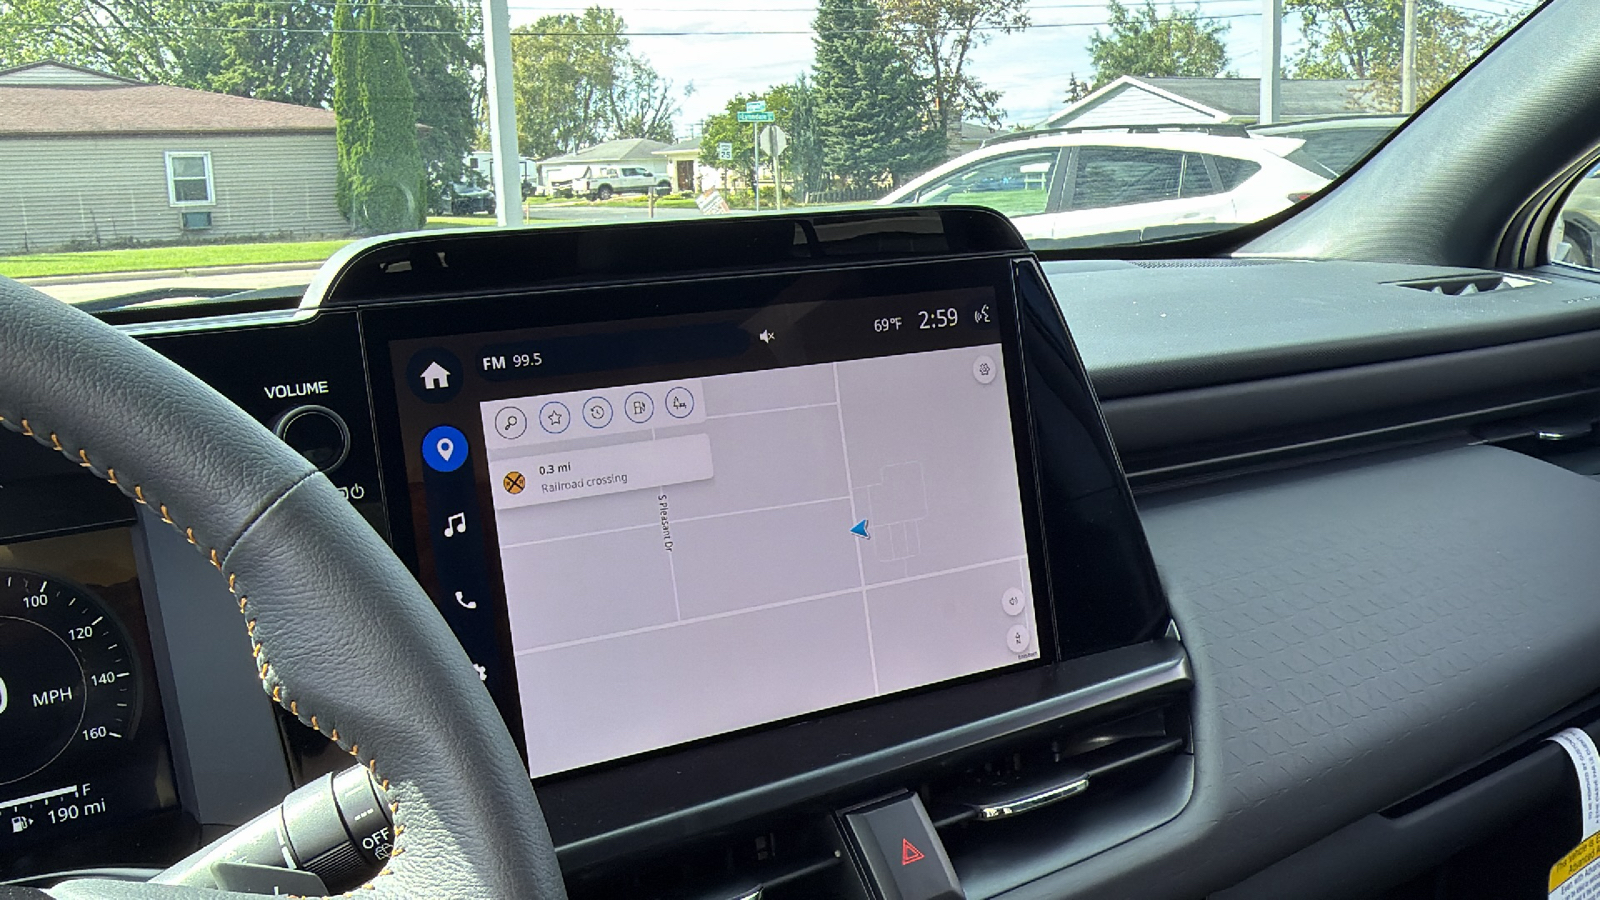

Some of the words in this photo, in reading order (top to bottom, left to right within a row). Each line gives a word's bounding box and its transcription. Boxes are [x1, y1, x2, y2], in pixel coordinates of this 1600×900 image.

[720, 151, 731, 159] 25
[874, 317, 902, 332] 69°F
[918, 307, 959, 329] 2:59
[482, 356, 506, 371] FM
[512, 353, 543, 368] 99.5
[264, 381, 329, 399] VOLUME
[538, 464, 555, 476] 0.3
[557, 461, 571, 473] mi
[541, 477, 584, 494] Railroad
[586, 473, 628, 488] crossing
[659, 502, 671, 540] Pleasant
[664, 541, 674, 552] Dr
[23, 593, 49, 609] 100
[68, 625, 94, 641] 120
[91, 671, 116, 686] 140
[32, 686, 73, 708] MPH
[82, 725, 108, 741] 160
[81, 783, 91, 797] F
[48, 804, 79, 824] 190
[84, 797, 107, 817] mi
[362, 827, 390, 849] OFF
